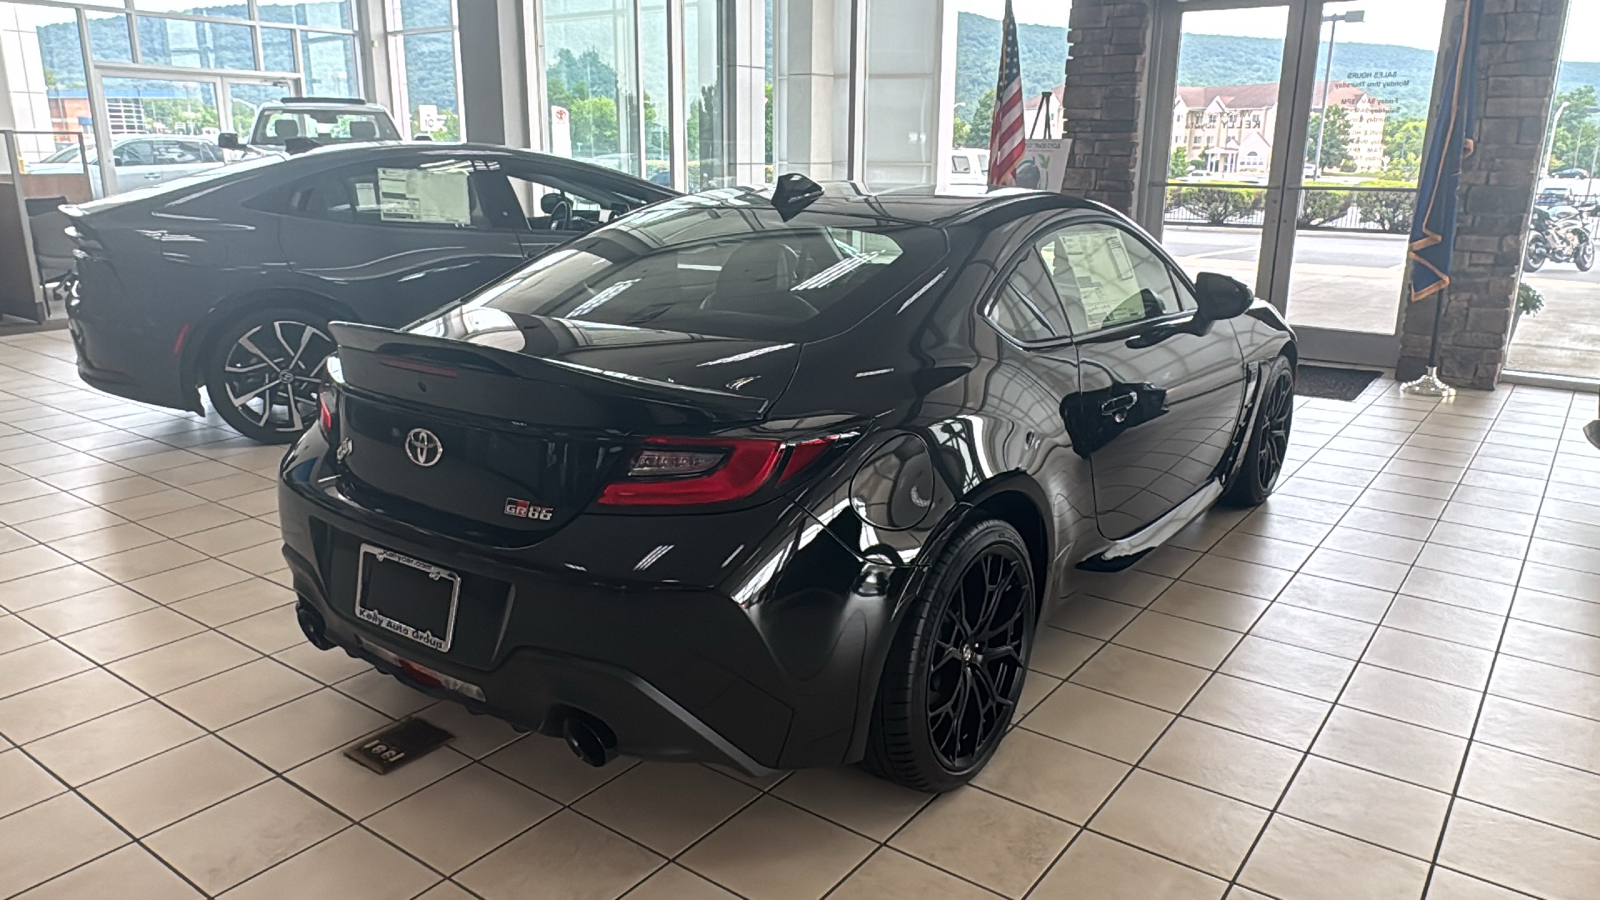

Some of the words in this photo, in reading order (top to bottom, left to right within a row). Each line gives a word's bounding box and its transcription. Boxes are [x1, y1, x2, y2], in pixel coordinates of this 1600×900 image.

[359, 608, 383, 625] Kelly
[386, 619, 409, 636] Auto
[411, 629, 443, 649] Group
